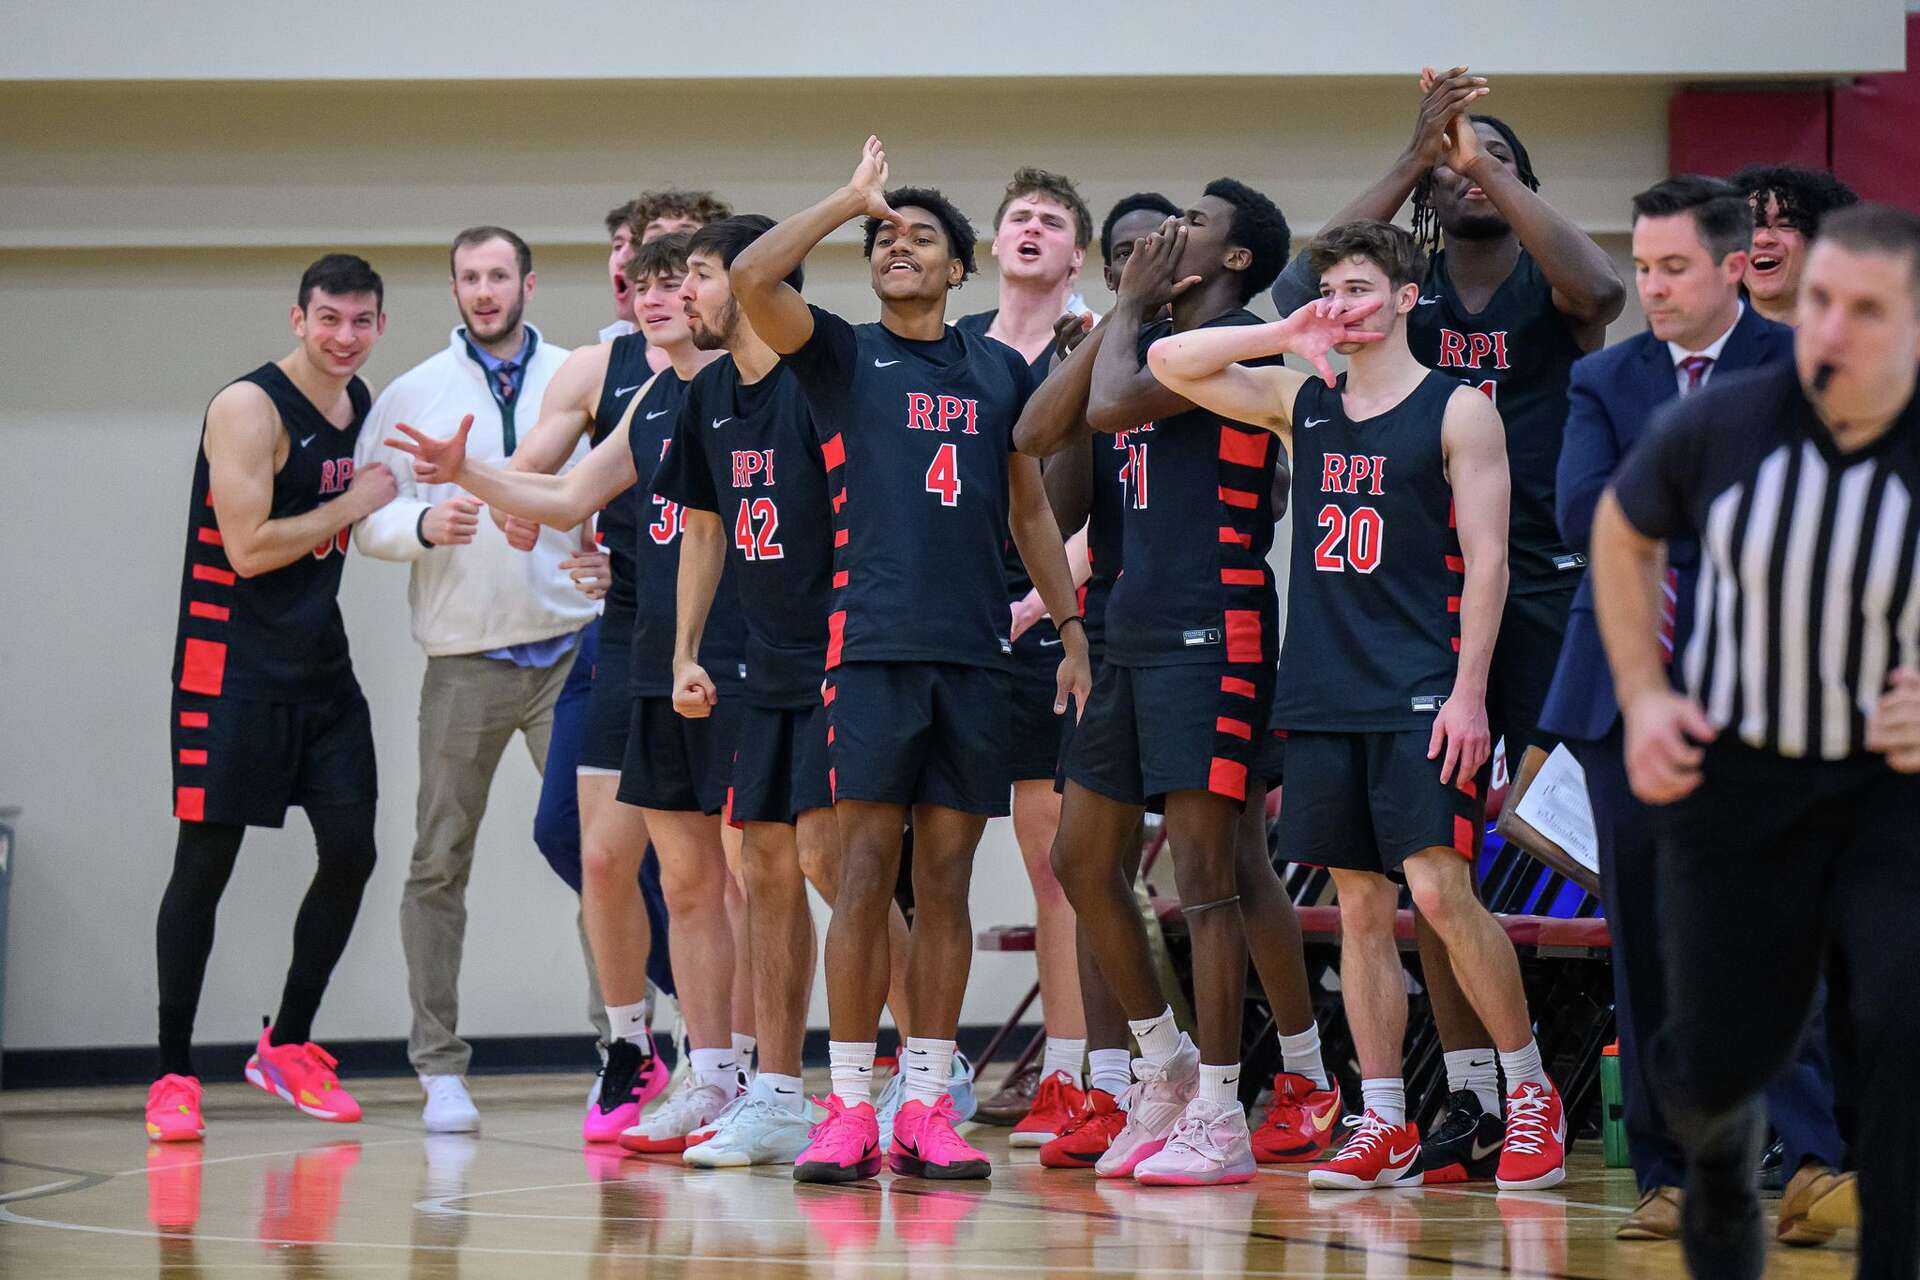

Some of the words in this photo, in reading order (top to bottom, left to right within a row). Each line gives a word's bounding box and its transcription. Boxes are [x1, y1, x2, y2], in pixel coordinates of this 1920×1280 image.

[1437, 328, 1511, 370] RPI
[906, 392, 979, 435] RPI
[318, 457, 354, 494] RP
[732, 449, 775, 488] RPI
[926, 443, 961, 507] 4
[1321, 453, 1387, 495] RPI
[735, 497, 784, 561] 42
[1314, 504, 1384, 574] 20
